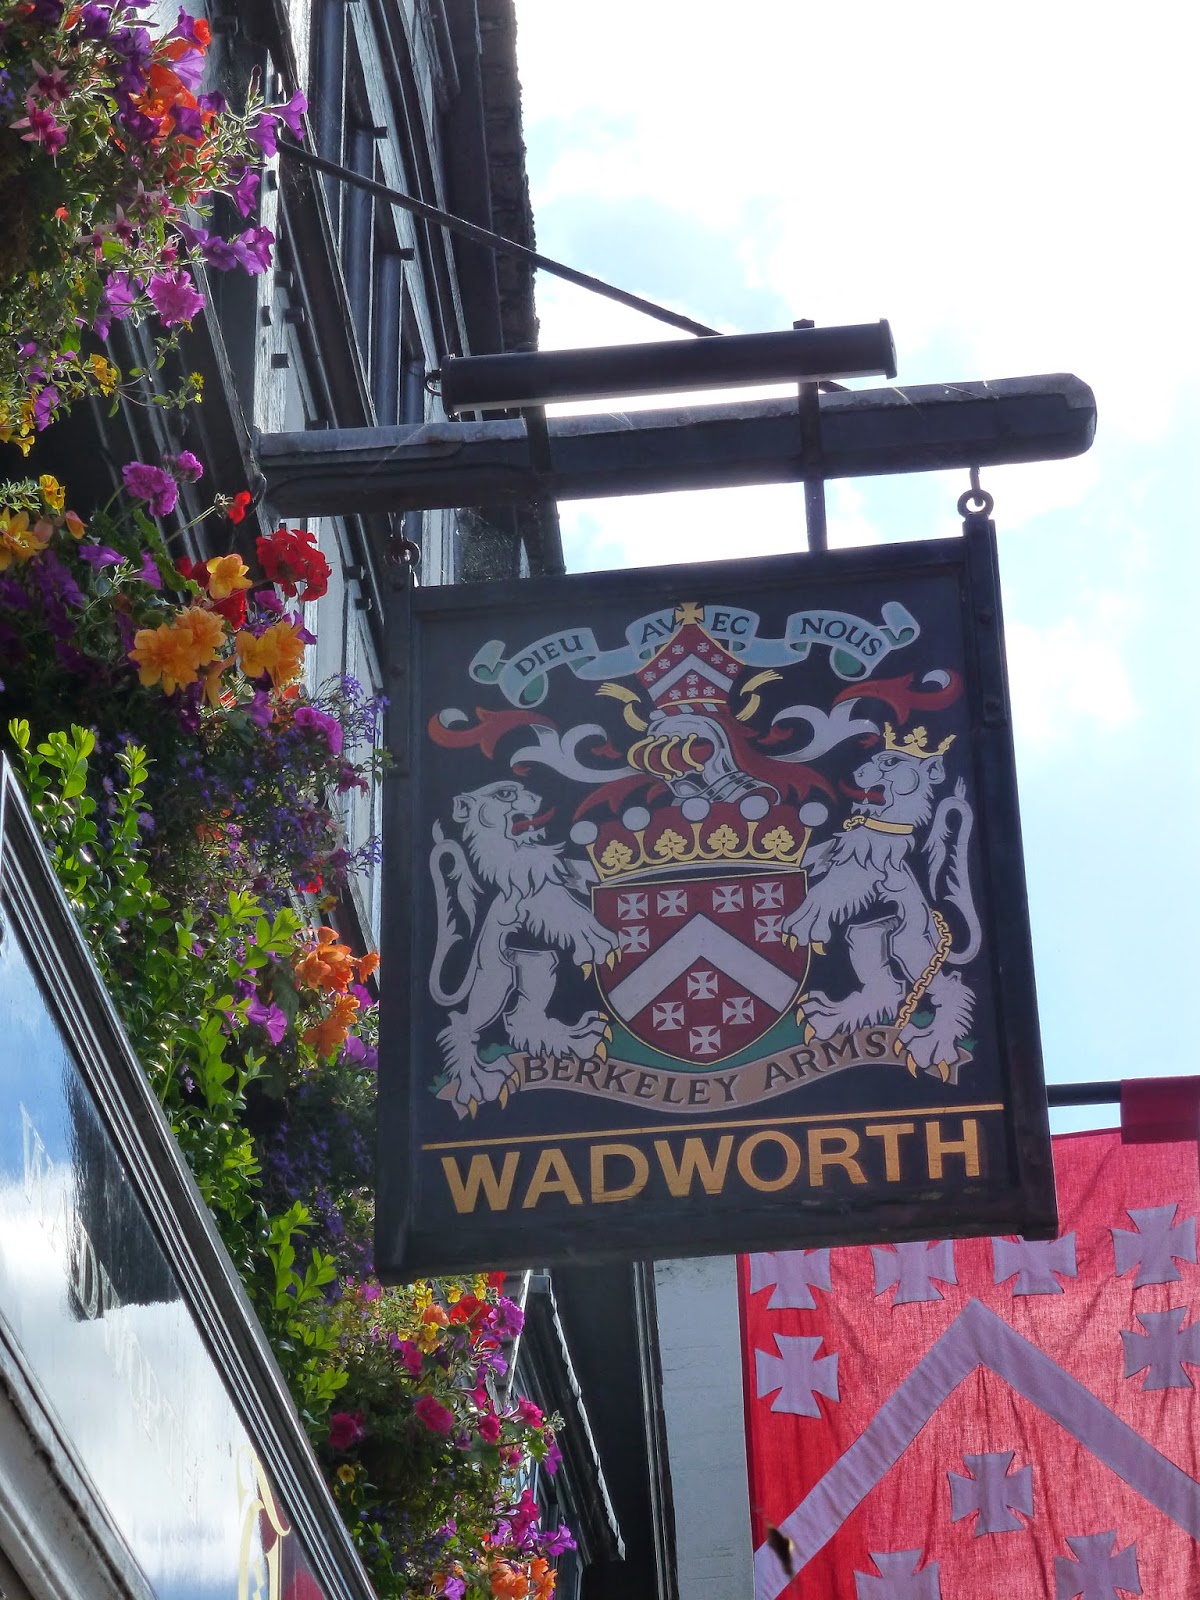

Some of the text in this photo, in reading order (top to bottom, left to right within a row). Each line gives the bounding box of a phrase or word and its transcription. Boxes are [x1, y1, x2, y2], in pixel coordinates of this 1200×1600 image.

[514, 635, 584, 677] DIEU
[800, 617, 883, 657] NOUS
[522, 1031, 887, 1105] BERKELEY ARMS
[441, 1118, 981, 1214] WADWORTH
